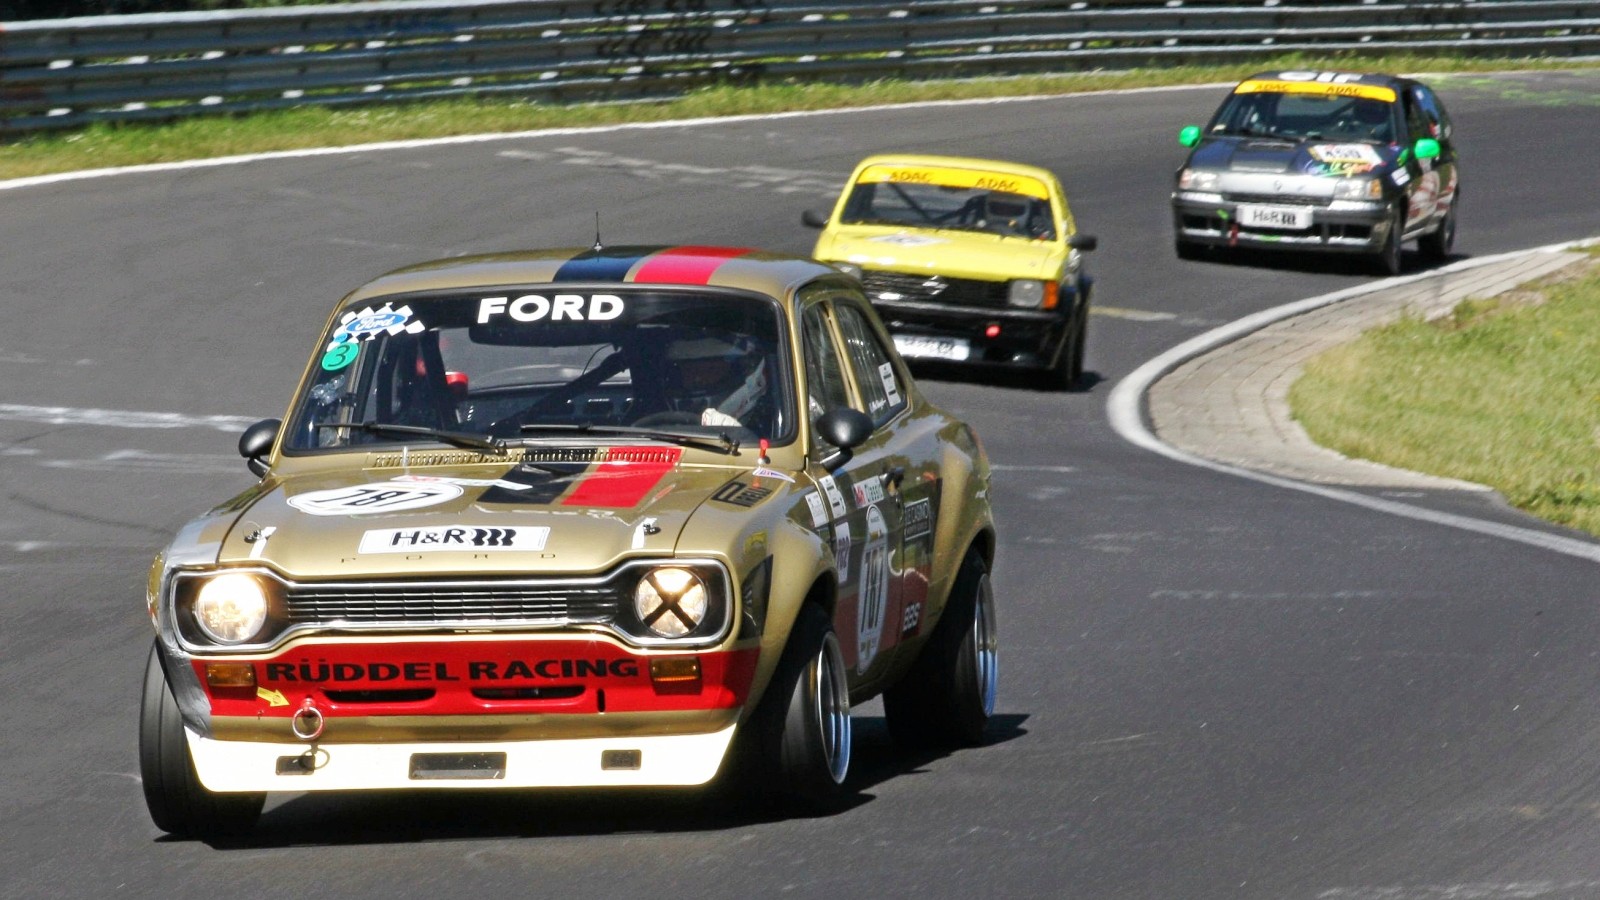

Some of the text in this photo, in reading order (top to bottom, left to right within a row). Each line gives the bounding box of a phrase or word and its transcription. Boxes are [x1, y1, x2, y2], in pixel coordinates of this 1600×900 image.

[1326, 86, 1362, 95] ADAC
[889, 171, 932, 182] ADAC
[976, 178, 1021, 192] ADAC
[477, 295, 625, 323] FORD
[355, 315, 396, 330] Ford
[327, 345, 350, 367] 3
[314, 489, 440, 507] 787
[391, 528, 466, 546] H&R
[266, 658, 640, 682] RÜDDEL RACING
